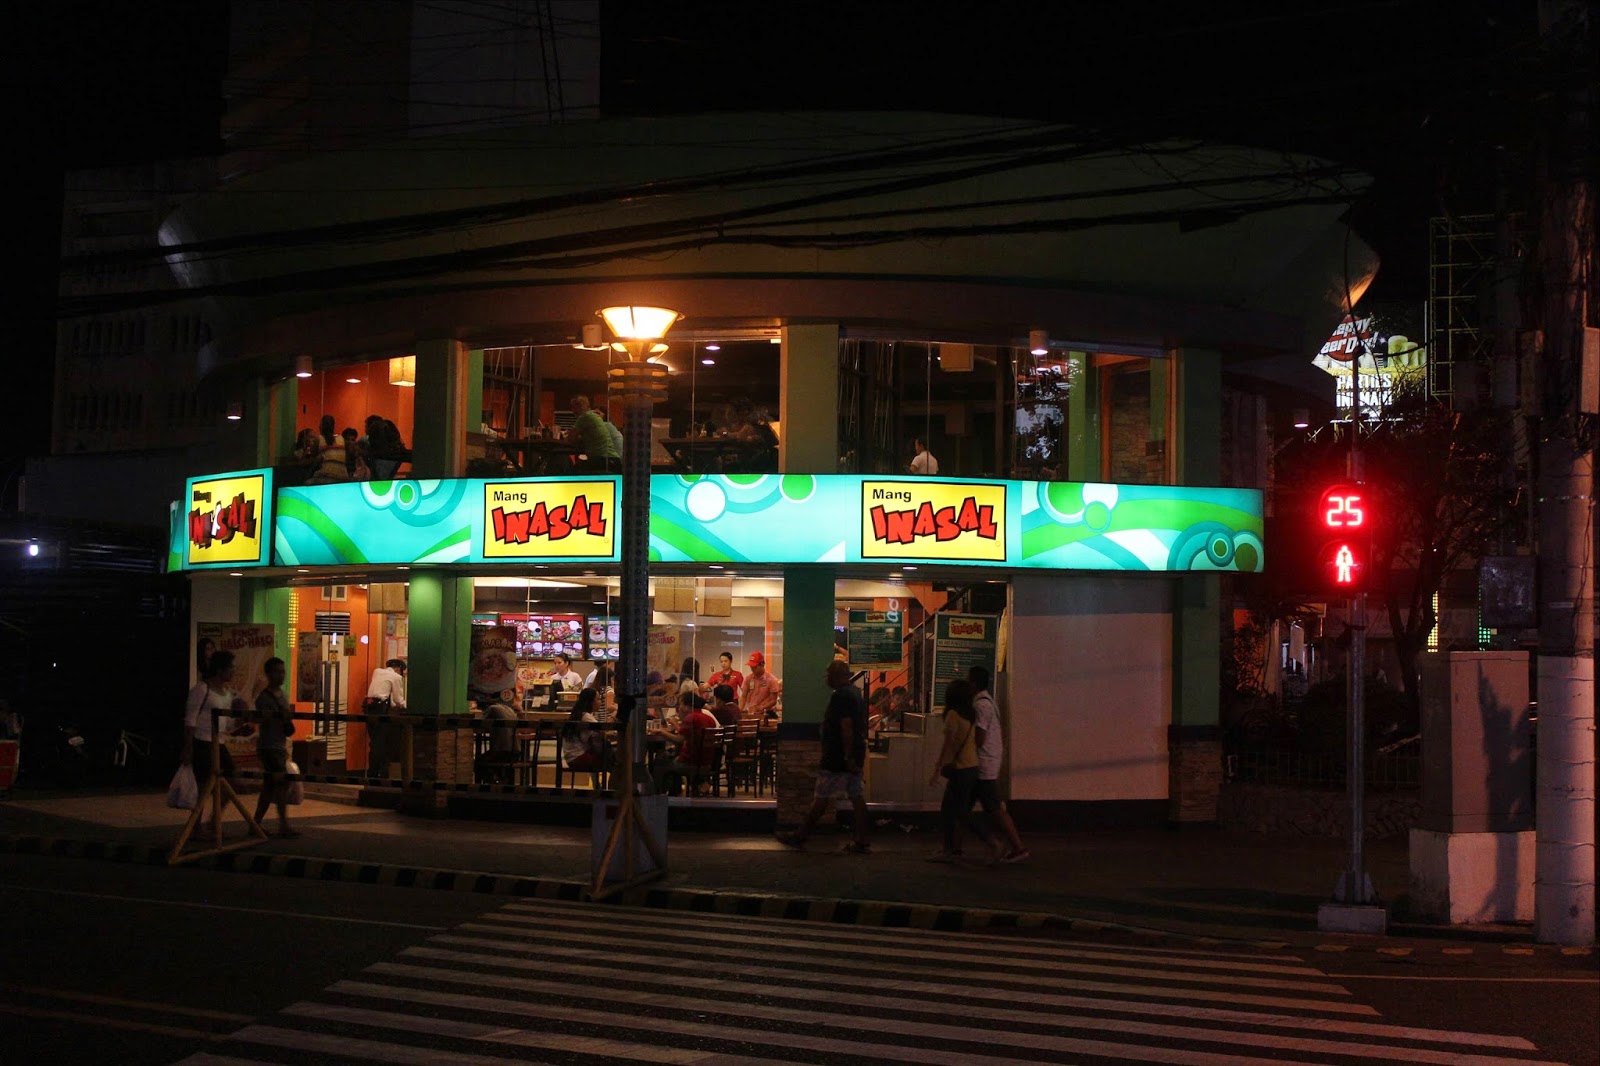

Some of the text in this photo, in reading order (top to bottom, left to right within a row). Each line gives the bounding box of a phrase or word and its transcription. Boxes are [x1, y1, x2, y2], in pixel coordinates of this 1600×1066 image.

[1320, 338, 1347, 354] eer
[493, 490, 528, 503] Mang
[872, 488, 912, 503] Mang
[491, 494, 607, 545] INASAL
[870, 496, 998, 545] INASAL
[1327, 496, 1363, 526] 25
